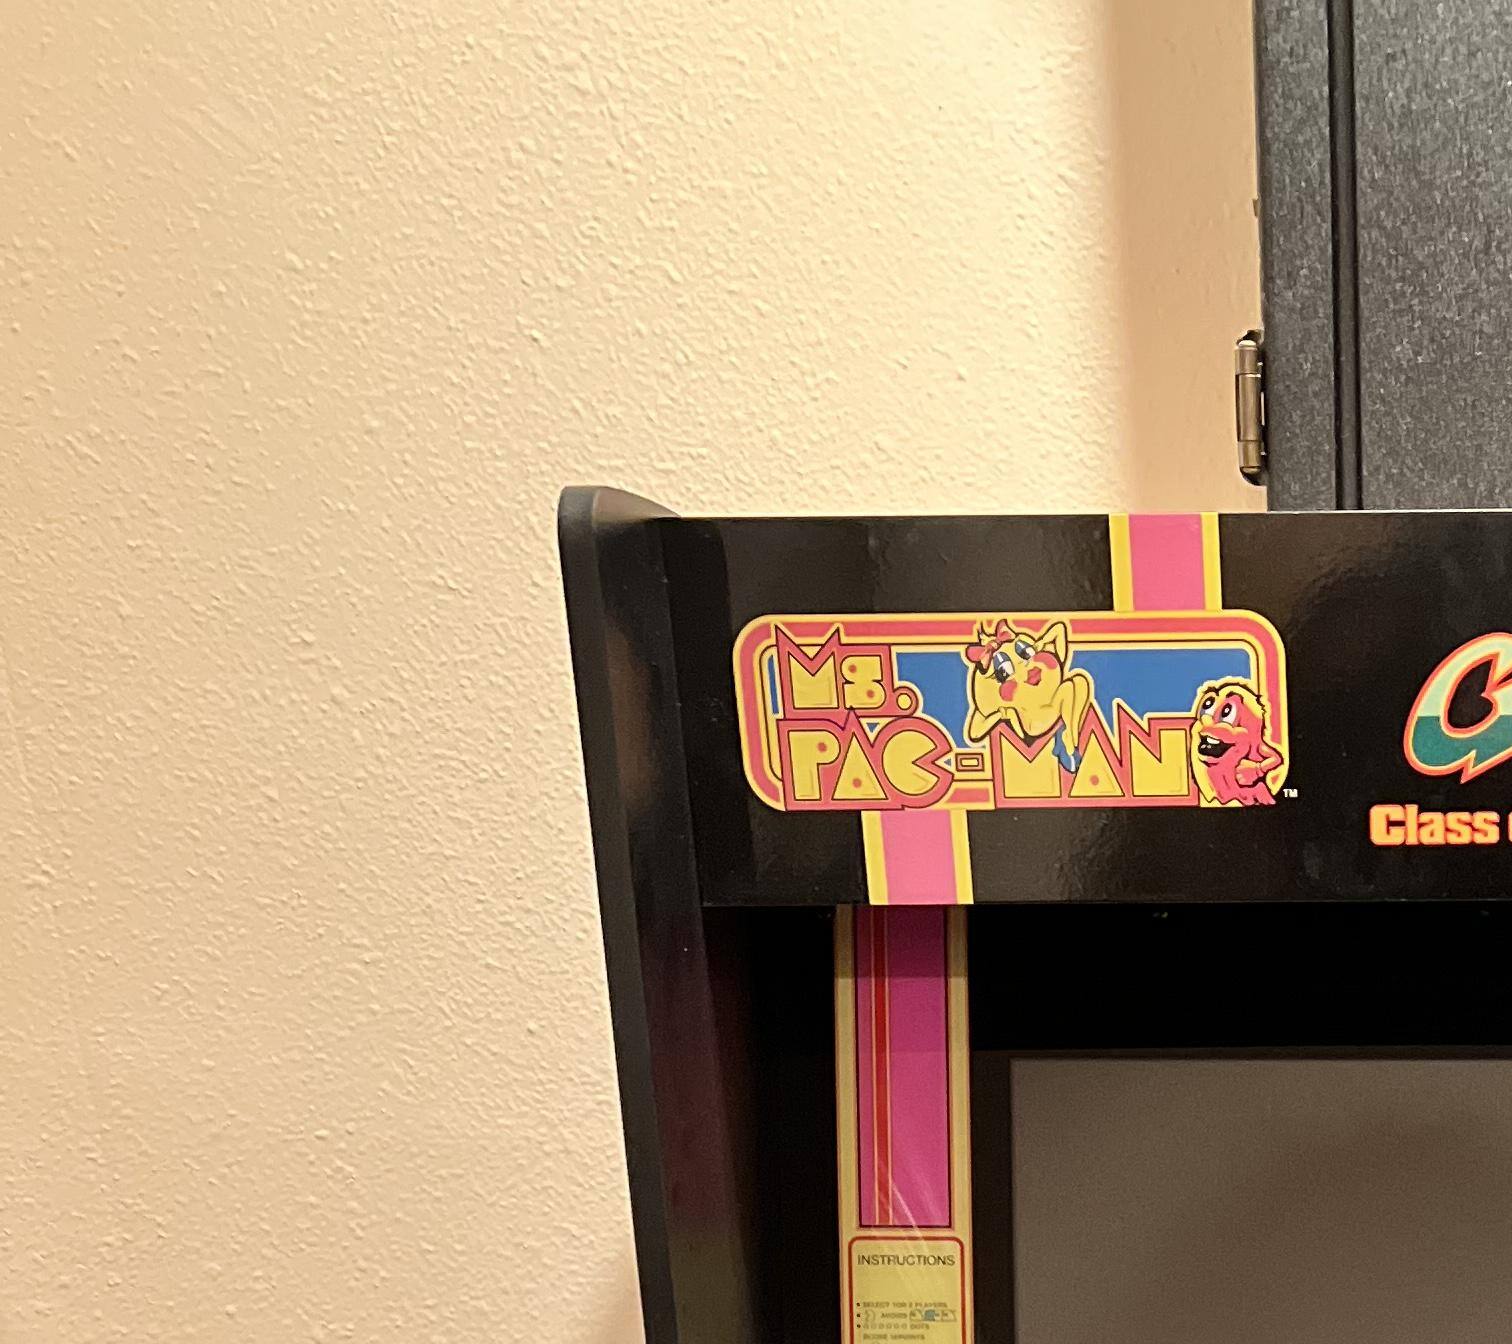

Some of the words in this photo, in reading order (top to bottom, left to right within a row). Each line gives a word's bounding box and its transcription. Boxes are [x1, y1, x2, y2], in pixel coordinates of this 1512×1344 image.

[782, 706, 1198, 808] PAC-MAN
[1368, 803, 1501, 847] Class
[857, 1254, 955, 1266] INSTRUCTIONS
